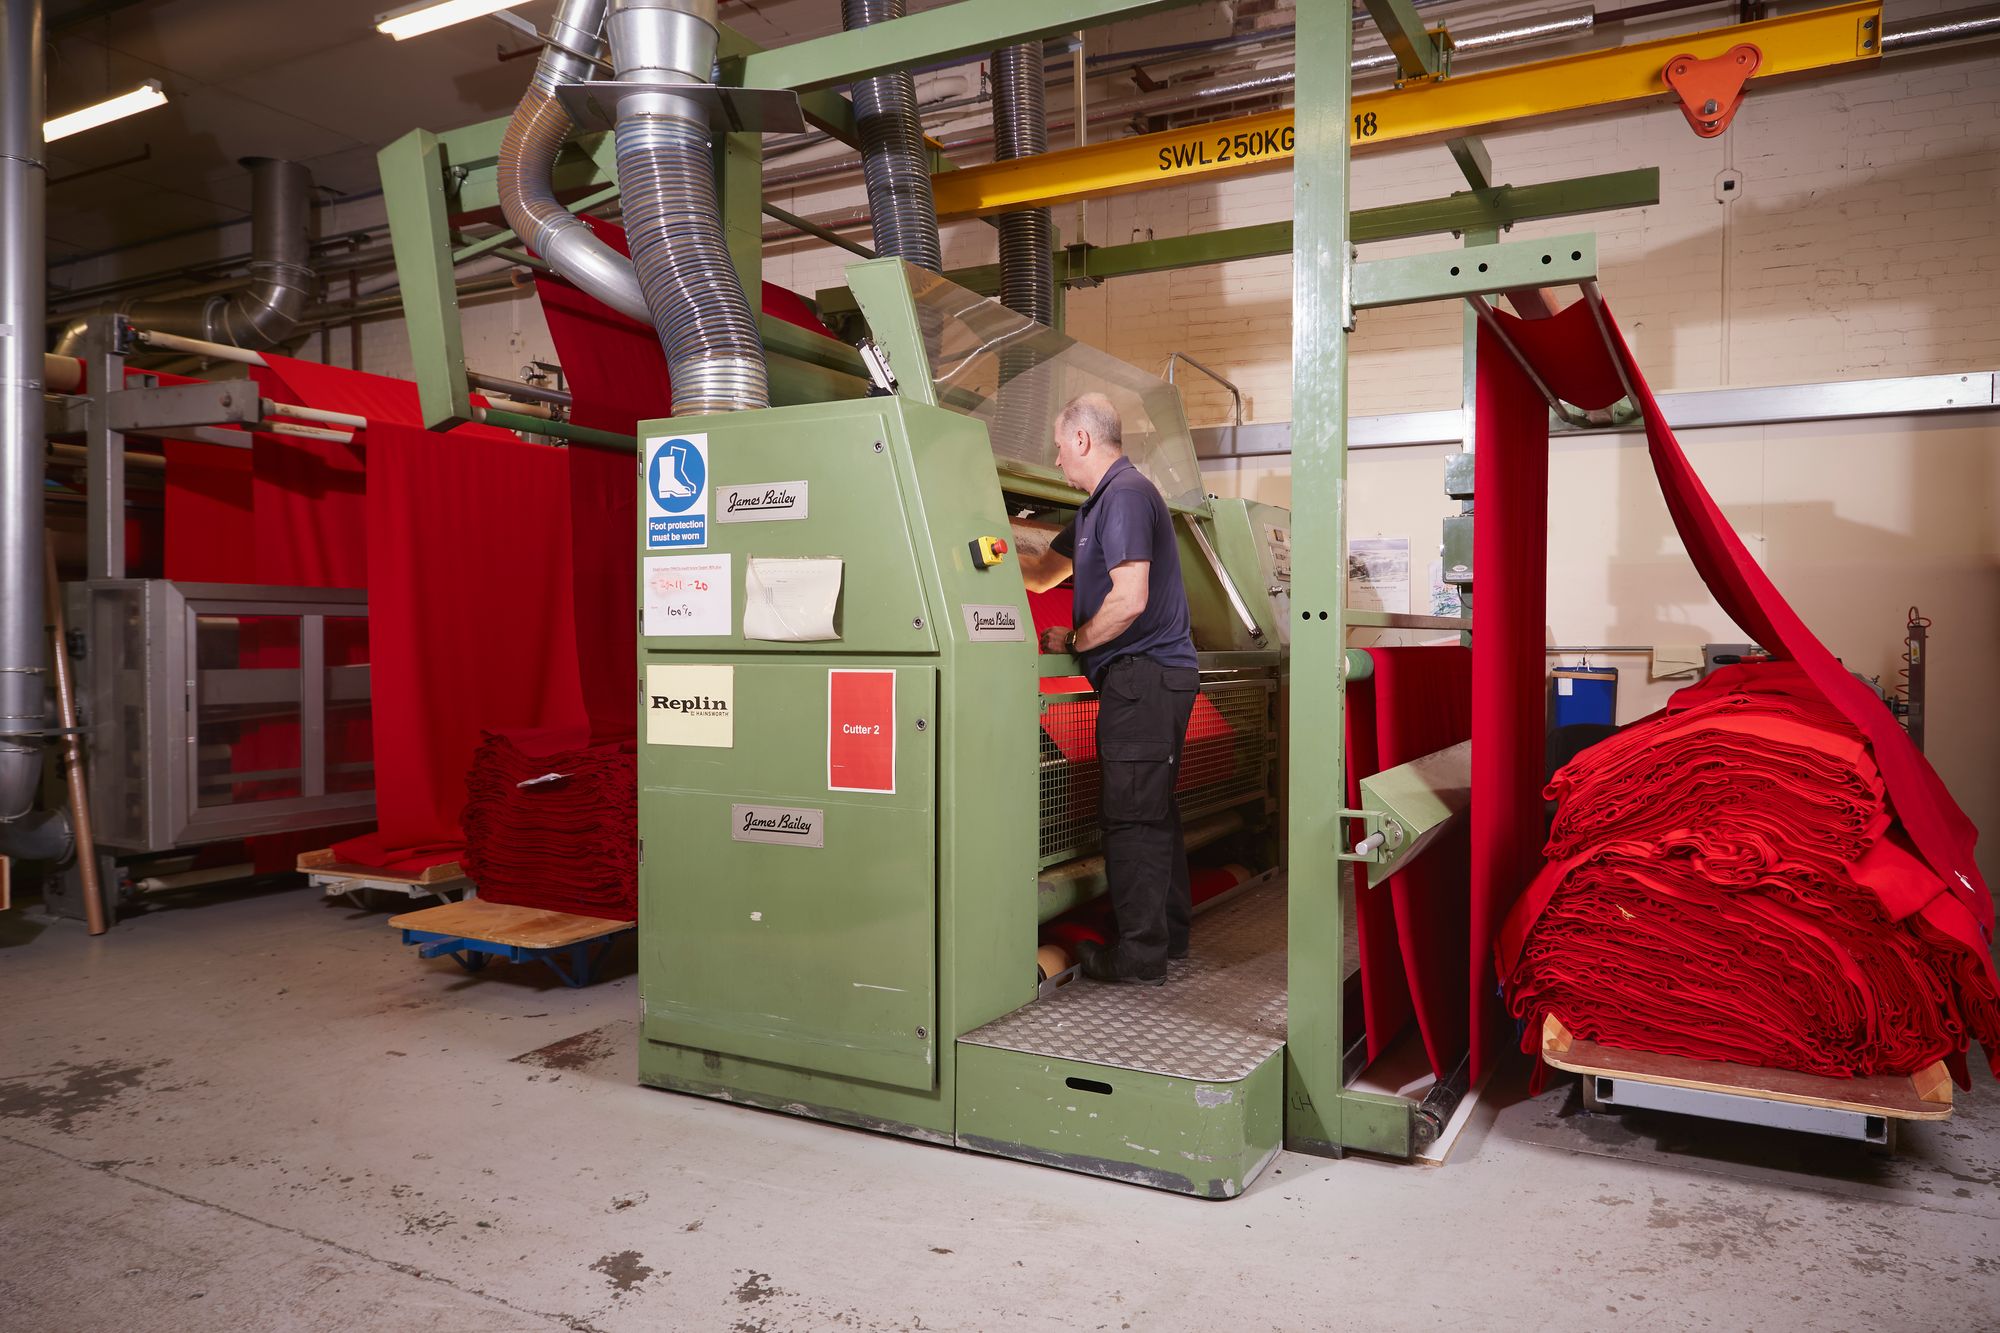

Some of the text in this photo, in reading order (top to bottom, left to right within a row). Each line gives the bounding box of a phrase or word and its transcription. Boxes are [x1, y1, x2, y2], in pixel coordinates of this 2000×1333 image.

[1354, 112, 1378, 140] 18
[1159, 127, 1294, 171] SWL 250KG
[728, 489, 796, 513] James Bailey
[650, 520, 704, 531] Foot protection
[652, 533, 670, 542] must
[671, 533, 681, 541] be
[667, 603, 693, 617] 100%
[973, 611, 1016, 631] James Bailey
[651, 695, 728, 714] Replin
[843, 724, 880, 735] Cutter 2
[743, 811, 812, 834] James Bailey
